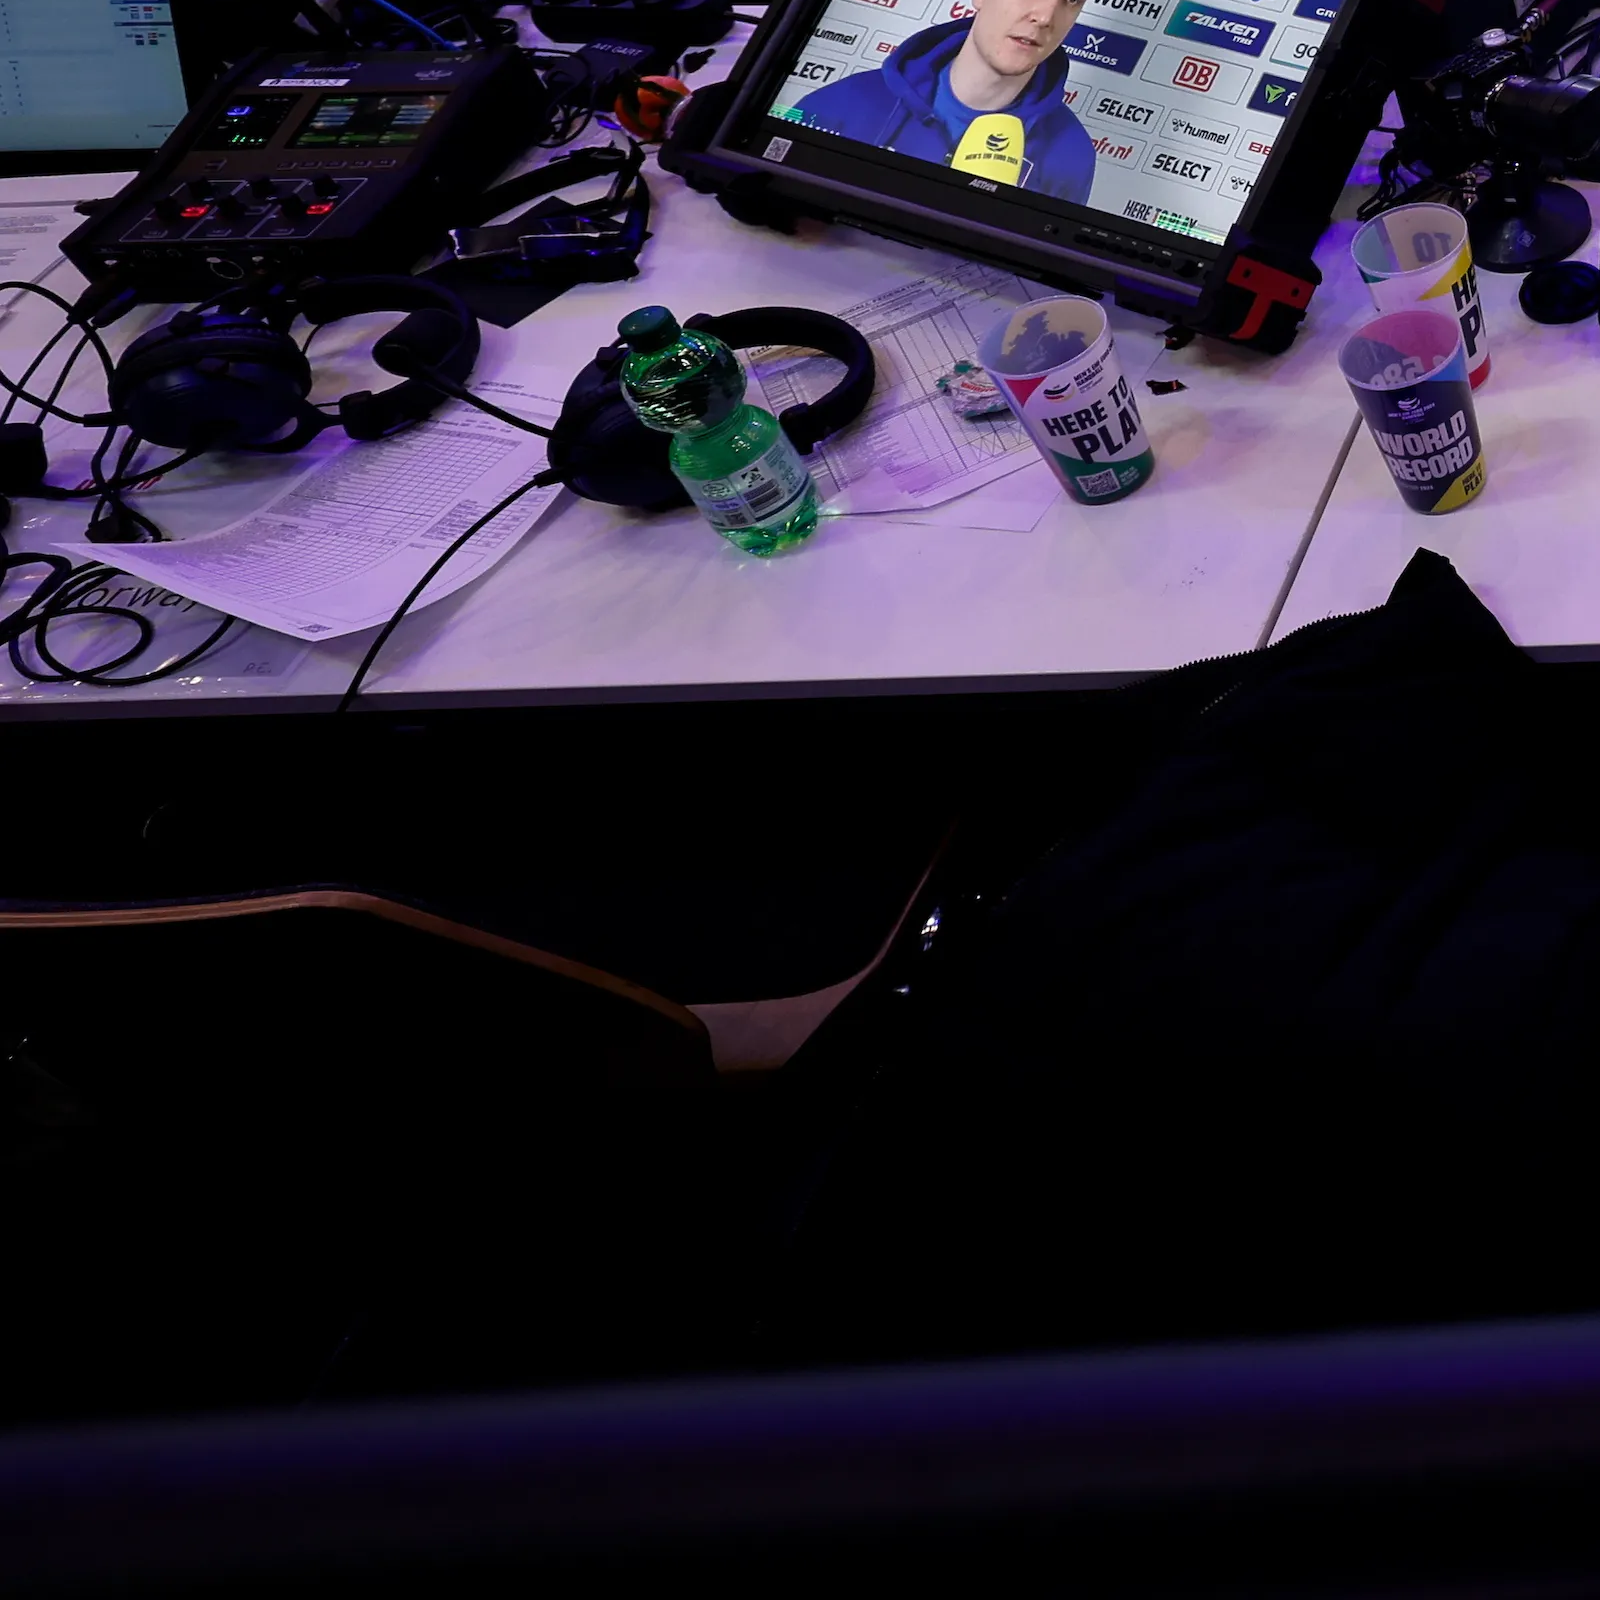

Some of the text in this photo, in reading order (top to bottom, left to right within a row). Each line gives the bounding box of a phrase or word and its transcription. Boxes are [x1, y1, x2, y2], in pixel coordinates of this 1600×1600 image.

[813, 27, 858, 46] ummel
[1184, 11, 1260, 40] FALKEN
[791, 62, 836, 83] LECT
[1178, 62, 1215, 88] DB
[1096, 96, 1155, 126] SELECT
[1183, 122, 1232, 146] hummel
[1151, 152, 1212, 183] SELECT
[1123, 199, 1152, 223] HERE
[1041, 375, 1129, 437] HERE TO
[1071, 393, 1143, 466] PLAY
[1374, 409, 1468, 457] WORLD
[1385, 435, 1474, 483] RECORD
[1463, 474, 1484, 496] PLAY
